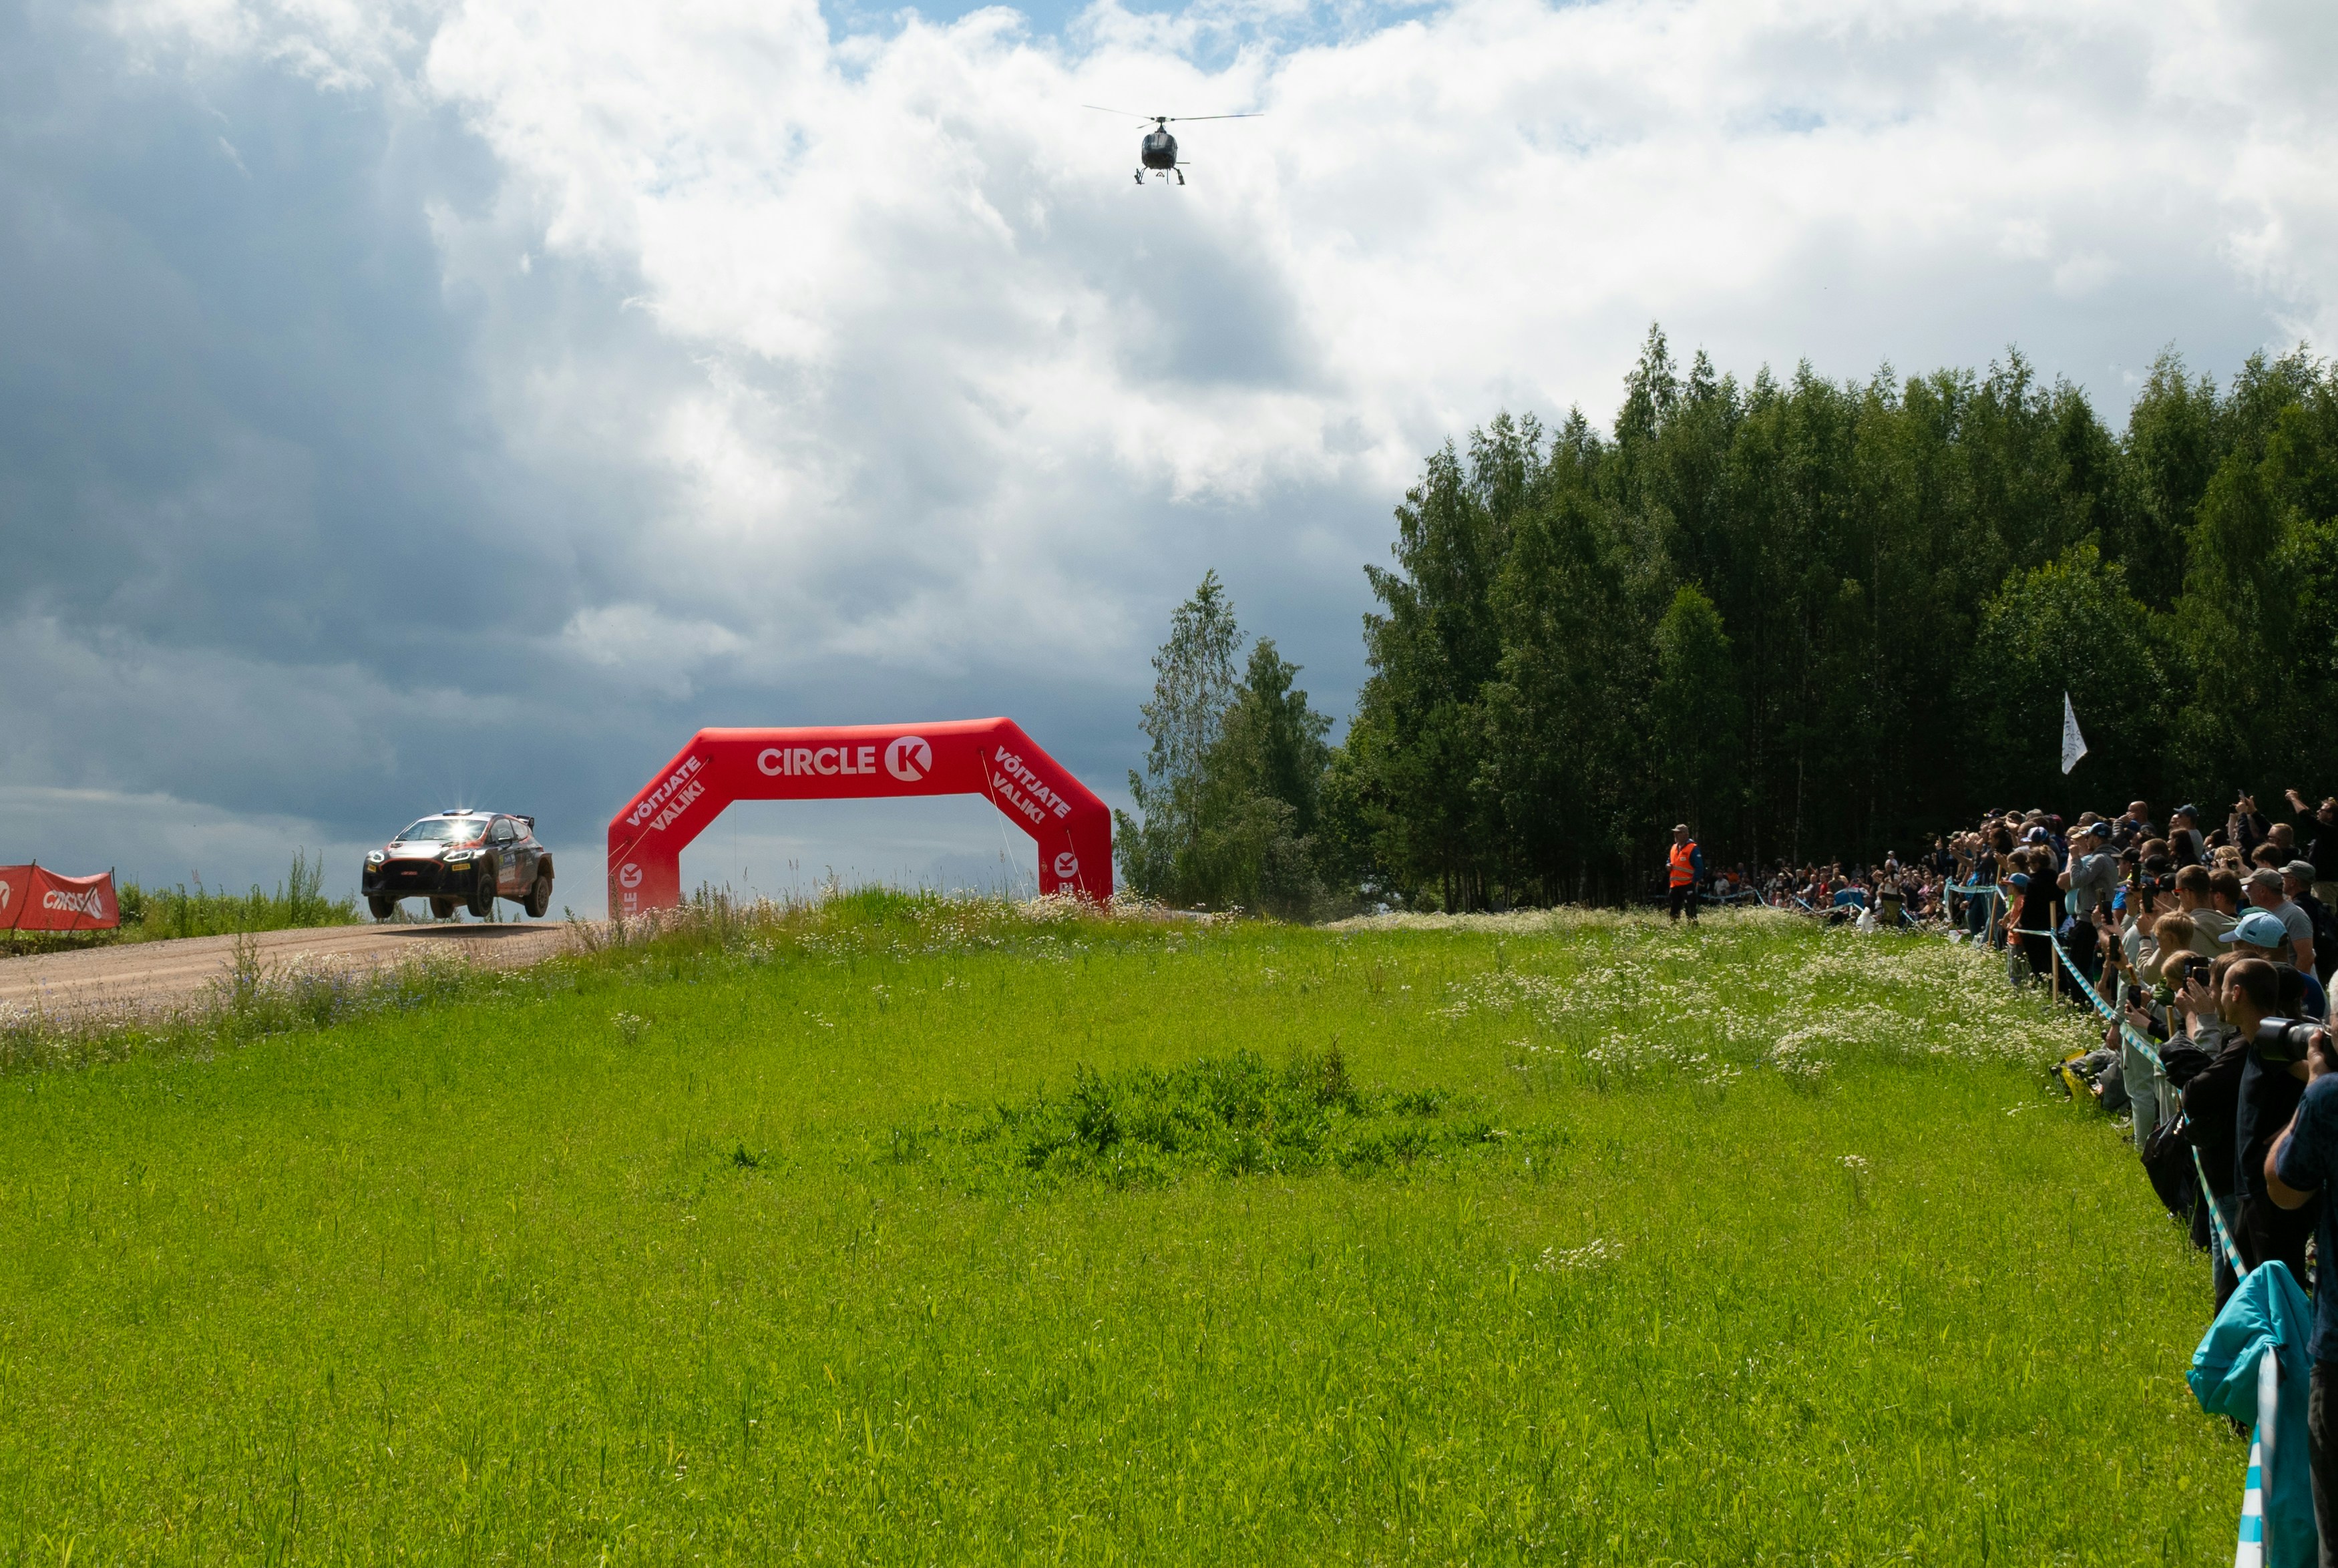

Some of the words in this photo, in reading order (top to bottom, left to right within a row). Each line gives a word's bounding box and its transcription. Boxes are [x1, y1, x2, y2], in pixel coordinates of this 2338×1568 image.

[757, 746, 877, 777] CIRCLE
[897, 743, 931, 779] K
[994, 745, 1073, 819] VÕITJATE
[626, 755, 702, 827] VÕITJATE
[649, 779, 706, 831] VALIK!
[992, 770, 1046, 825] VALIK!
